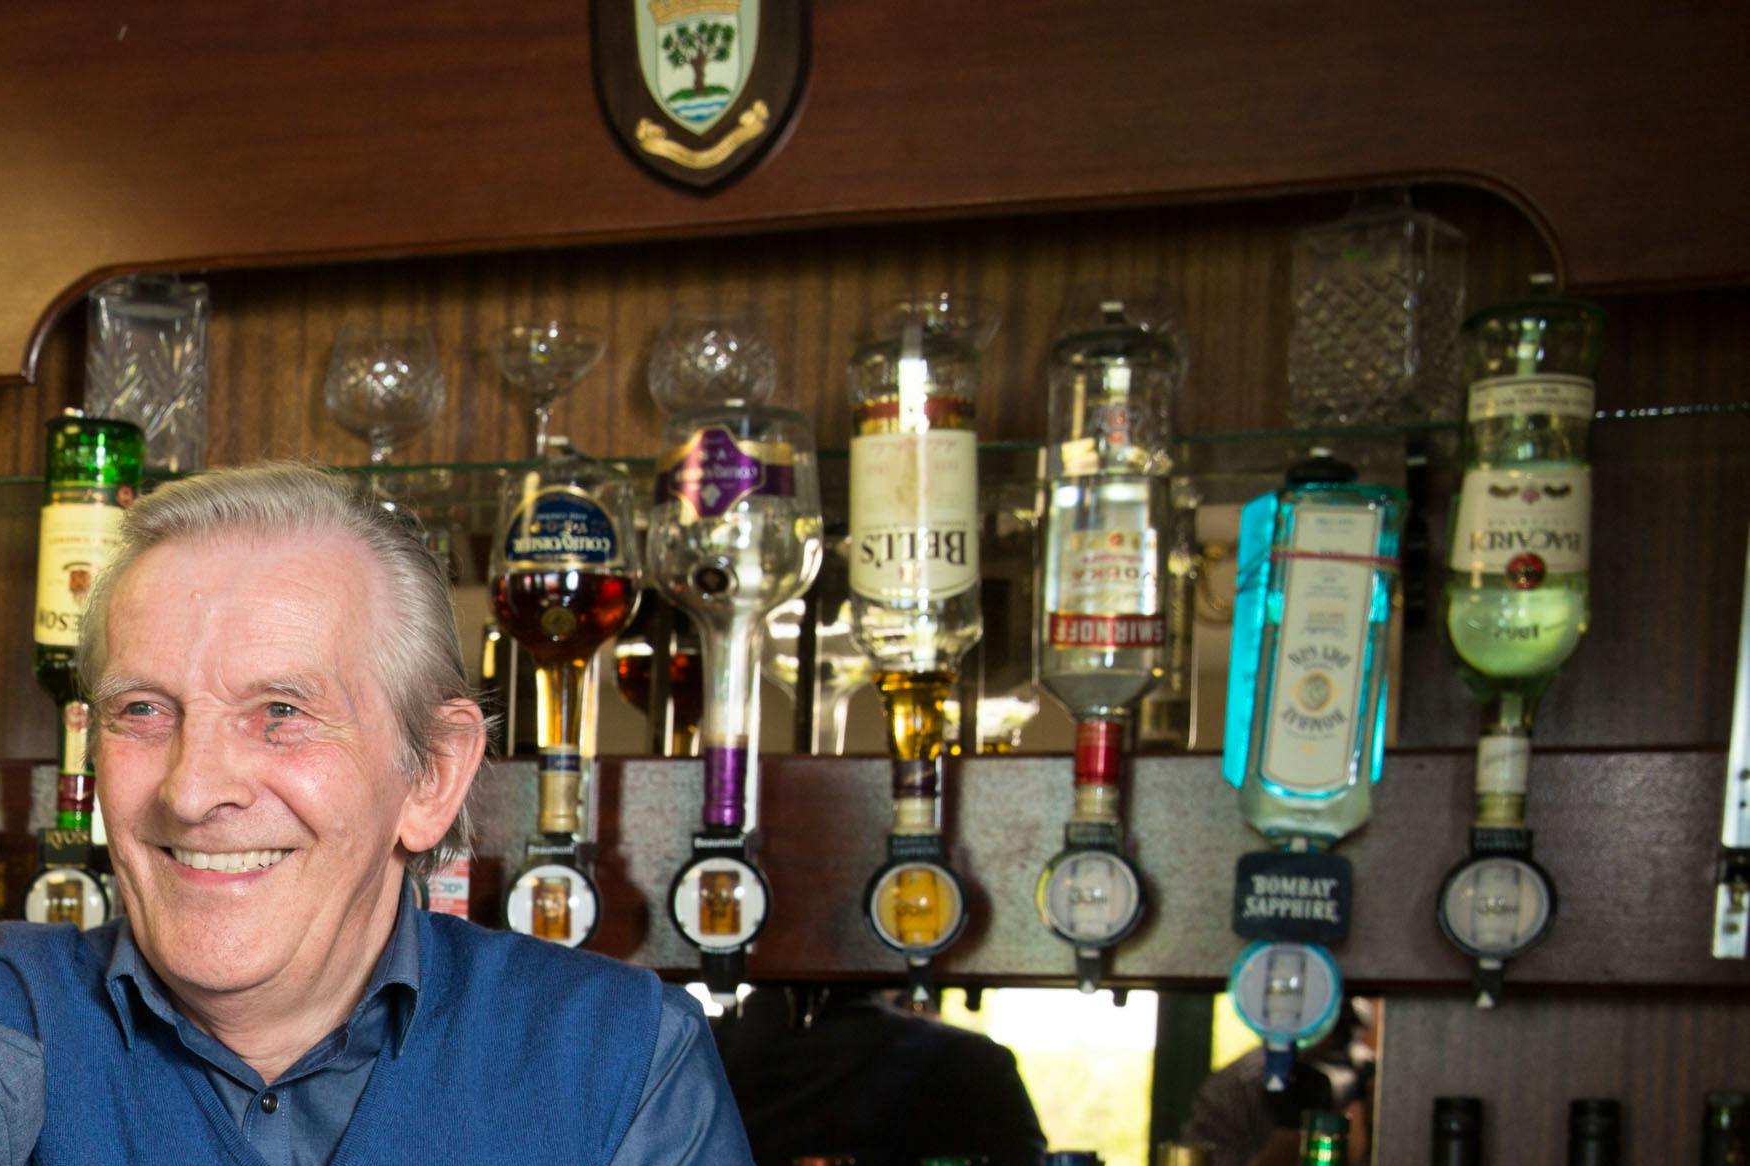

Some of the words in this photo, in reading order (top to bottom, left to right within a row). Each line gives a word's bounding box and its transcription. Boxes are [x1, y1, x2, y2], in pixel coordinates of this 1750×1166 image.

[861, 531, 967, 570] BELL'S
[1468, 528, 1581, 553] BACARDI
[1053, 619, 1164, 644] SMIRNOFF
[527, 844, 574, 856] Beaumont
[694, 837, 743, 849] Beaumont
[1251, 874, 1338, 899] BOMBAY
[1243, 896, 1339, 923] SAPPHIRE
